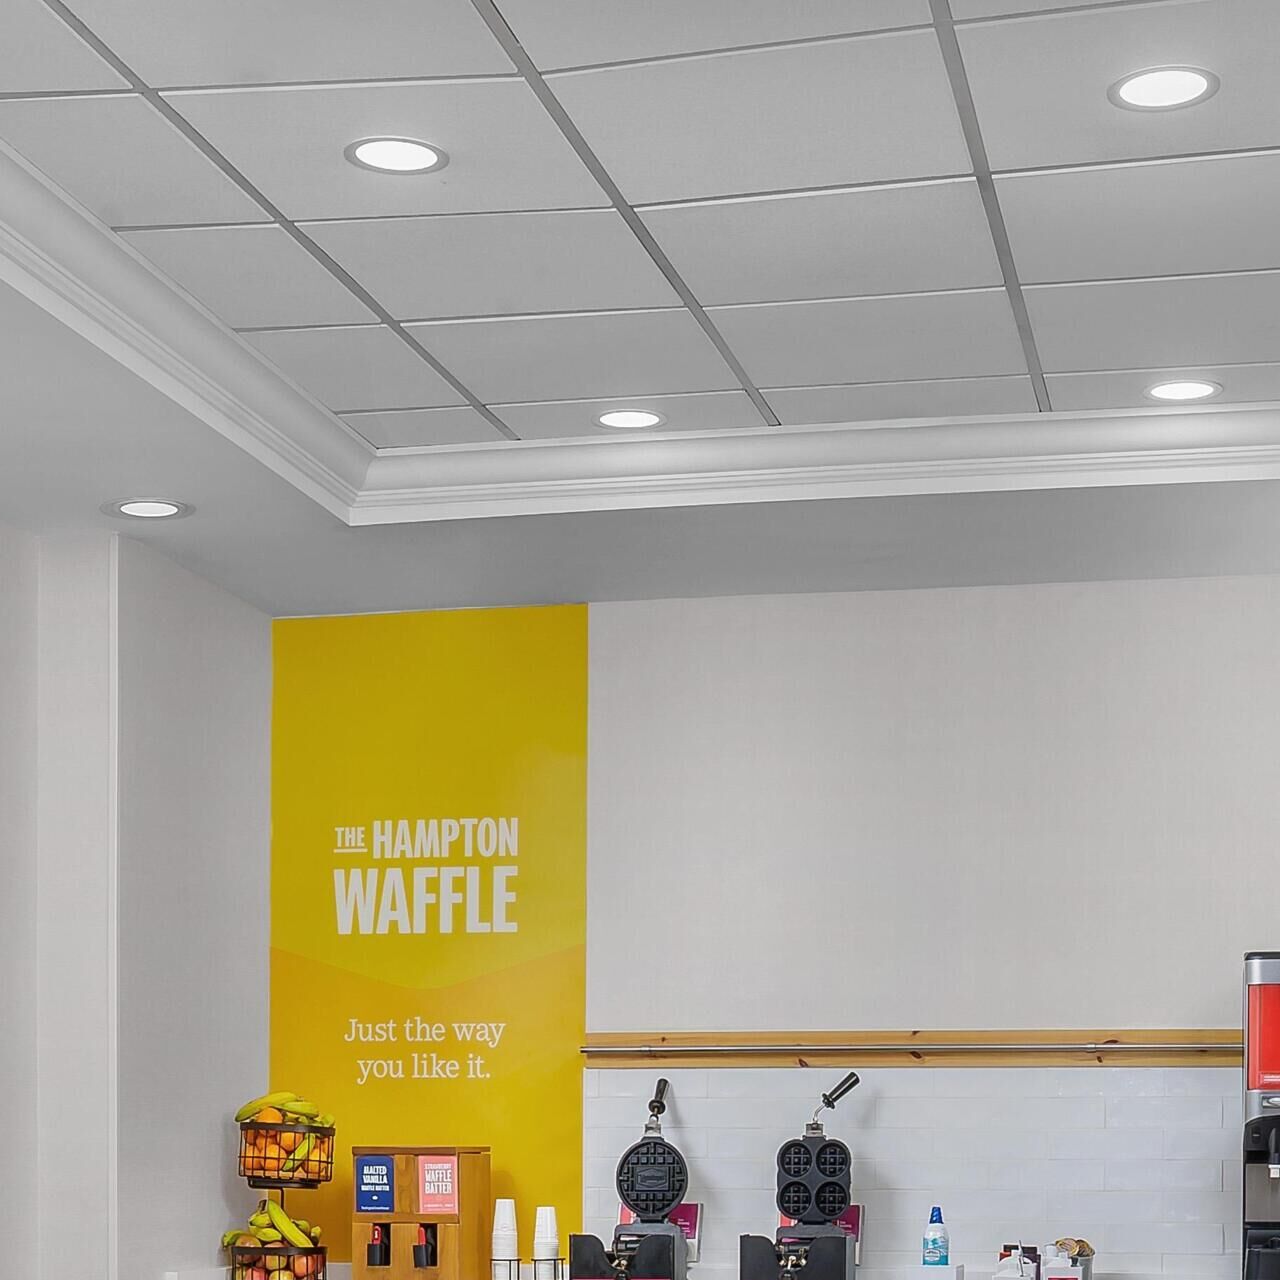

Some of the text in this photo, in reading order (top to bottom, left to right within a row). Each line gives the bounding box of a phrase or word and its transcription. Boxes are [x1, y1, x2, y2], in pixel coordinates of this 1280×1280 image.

[334, 817, 519, 860] THE HAMPTON
[332, 865, 519, 935] WAFFLE
[343, 1016, 507, 1048] Just the way
[355, 1053, 491, 1085] you like it.
[362, 1175, 388, 1184] VANILLA
[424, 1169, 452, 1182] WAFFLE
[424, 1182, 452, 1194] BATTER
